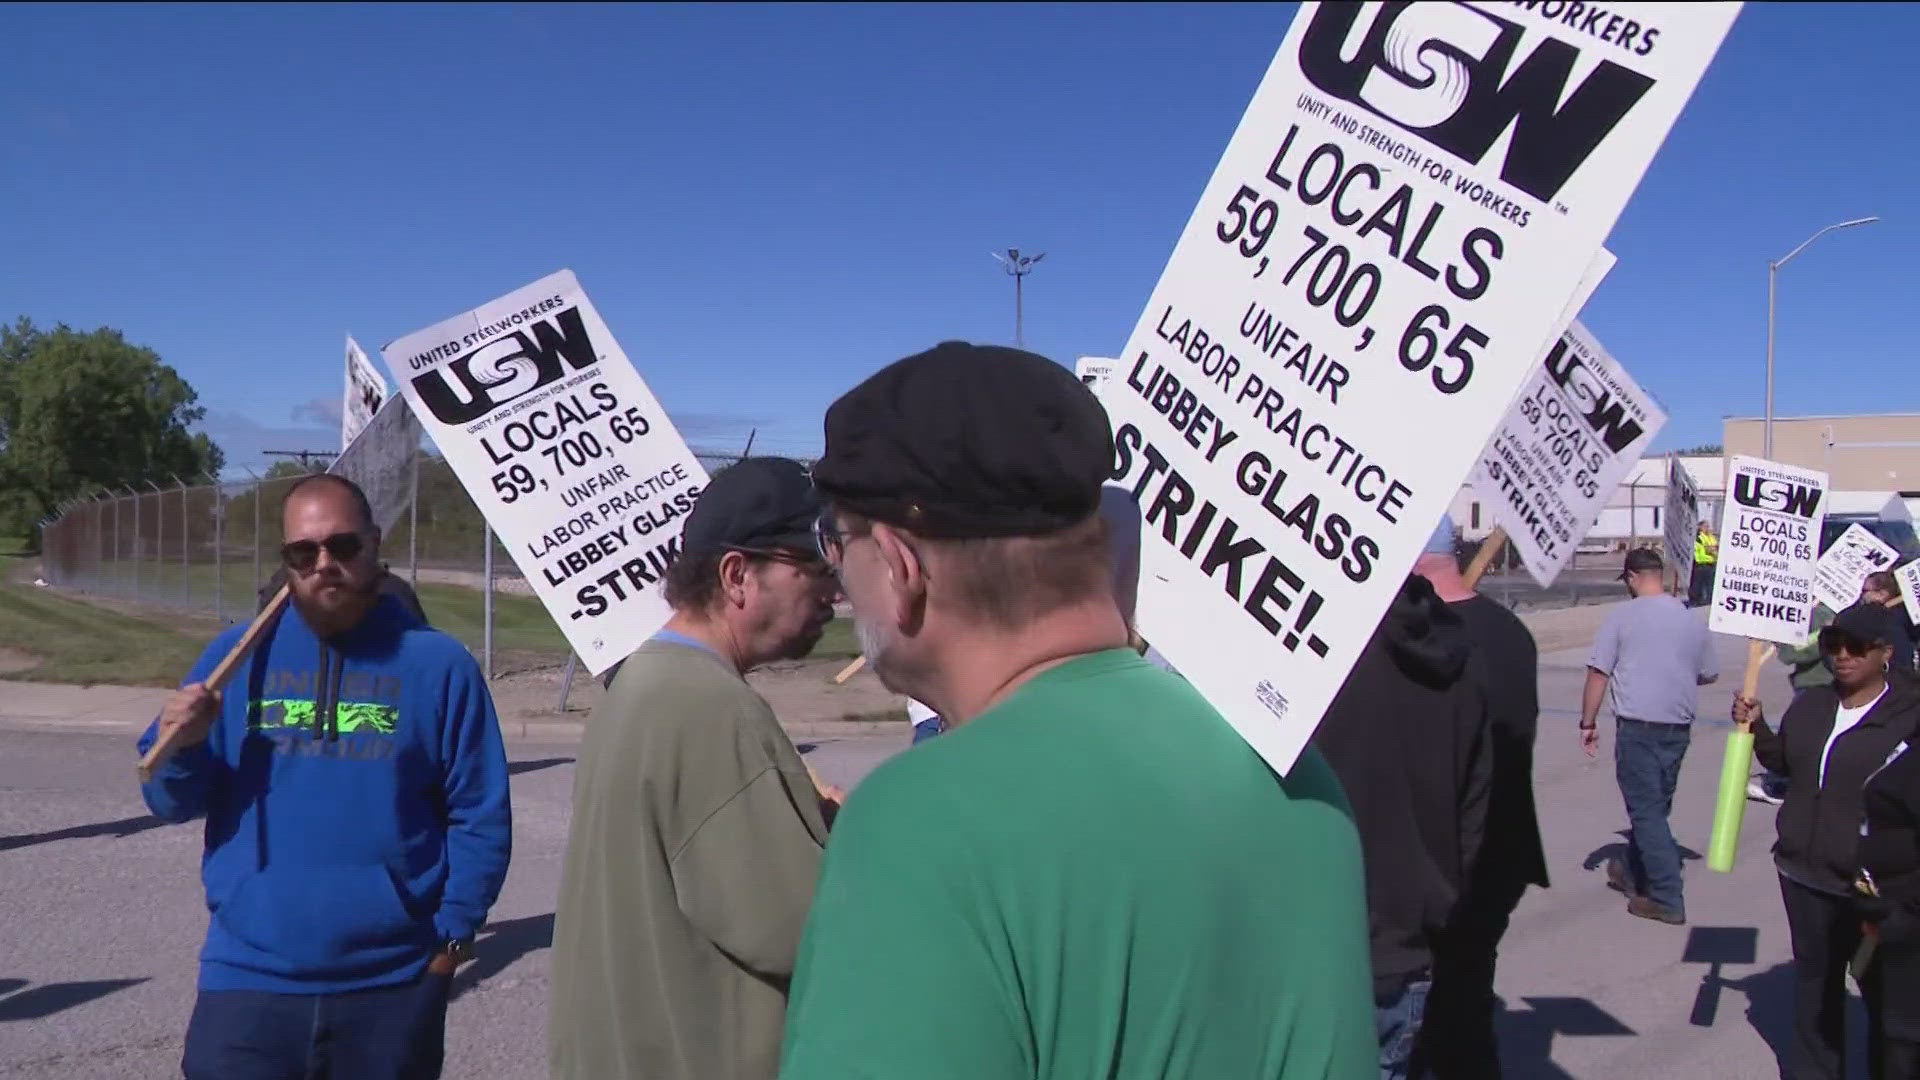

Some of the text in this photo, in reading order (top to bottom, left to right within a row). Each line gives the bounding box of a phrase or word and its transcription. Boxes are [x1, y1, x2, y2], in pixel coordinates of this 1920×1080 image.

[1299, 1, 1657, 204] USW
[1297, 93, 1531, 227] UNITY AND STRENGTH FOR WORKERS
[1265, 124, 1503, 300] LOCALS
[409, 295, 564, 370] UNITED STEELWORKERS
[1216, 184, 1491, 394] 59, 700, 65
[411, 305, 598, 425] USW
[1240, 302, 1350, 404] UNFAIR
[1545, 337, 1643, 454] USW
[480, 382, 618, 466] LOCALS
[491, 406, 650, 505] 59, 700, 65
[1156, 305, 1240, 393] LABOR
[1236, 374, 1413, 523] PRACTICE
[1521, 397, 1599, 499] 59, 700, 65
[1536, 385, 1603, 474] LOCALS
[527, 462, 688, 559] LABOR PRACTICE
[560, 464, 632, 508] UNFAIR
[1127, 351, 1380, 583] LIBBEY GLASS
[1494, 438, 1570, 543] LIBBEY GLASS
[1734, 473, 1822, 518] USW
[542, 486, 702, 588] LIBBEY GLASS
[570, 533, 686, 621] -STRIK
[1725, 565, 1809, 589] LABOR PRACTICE
[1731, 532, 1810, 560] 59, 700, 65
[1740, 515, 1807, 542] LOCALS
[1752, 557, 1789, 571] UNFAIR
[1719, 596, 1806, 624] -STRIKE!-
[1722, 578, 1808, 604] LIBBEY GLASS
